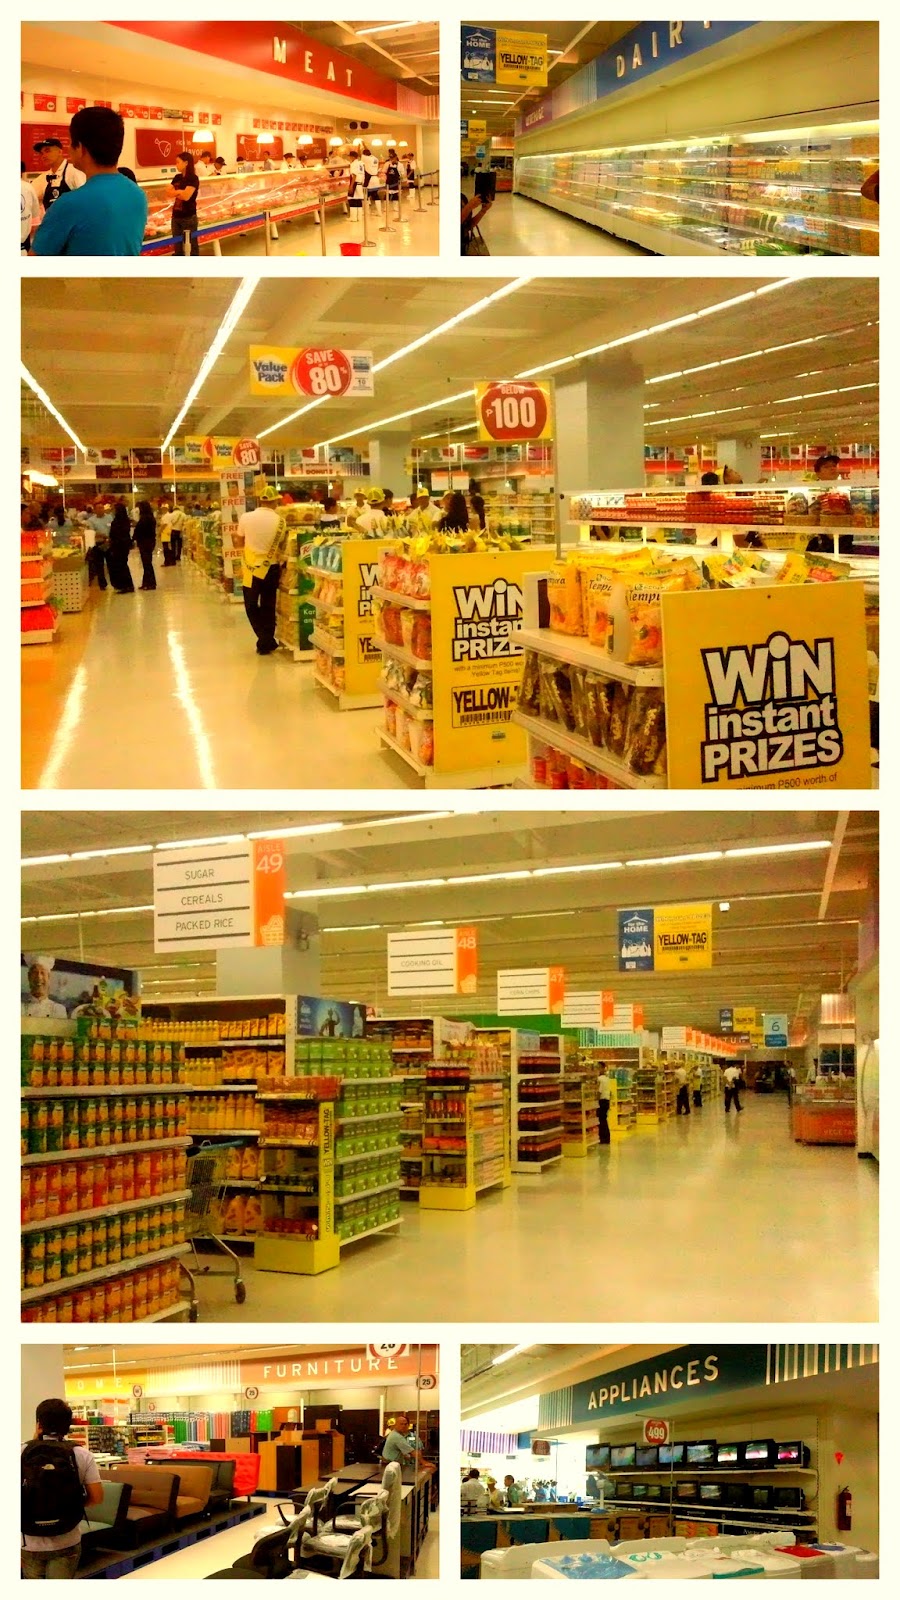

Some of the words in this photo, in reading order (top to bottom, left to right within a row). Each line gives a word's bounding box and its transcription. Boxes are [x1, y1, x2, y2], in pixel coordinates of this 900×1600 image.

[466, 40, 491, 48] HOME
[273, 36, 353, 87] MEAT
[500, 52, 544, 66] YELLOW-TAG
[184, 146, 203, 156] lavor
[305, 350, 334, 365] SAVE
[253, 361, 288, 374] Value
[258, 372, 285, 383] Pack
[501, 385, 525, 395] BELOW
[220, 472, 244, 480] FREE
[222, 498, 245, 506] FREE
[455, 617, 523, 639] instan
[452, 637, 525, 662] PRIZE
[705, 695, 837, 741] instant
[702, 729, 842, 782] PRIZES
[777, 777, 801, 789] P500
[803, 774, 827, 786] worth
[829, 773, 839, 782] of
[257, 844, 281, 853] AISLE
[256, 853, 283, 874] 49
[184, 868, 215, 881] SUGAR
[180, 893, 223, 906] CEREALS
[175, 919, 211, 932] PACKED
[213, 917, 234, 929] RICE
[623, 925, 649, 933] HOME
[457, 936, 477, 949] 48
[658, 932, 707, 946] YELLOW-TAG
[400, 960, 431, 968] COOKING
[771, 1021, 780, 1032] 6
[322, 1108, 330, 1155] YELLOW-TAG
[263, 1356, 399, 1379] FURNITURE
[77, 1377, 123, 1391] OME
[421, 1378, 432, 1386] 25
[587, 1354, 719, 1410] APPLIANCES
[648, 1426, 665, 1440] 499
